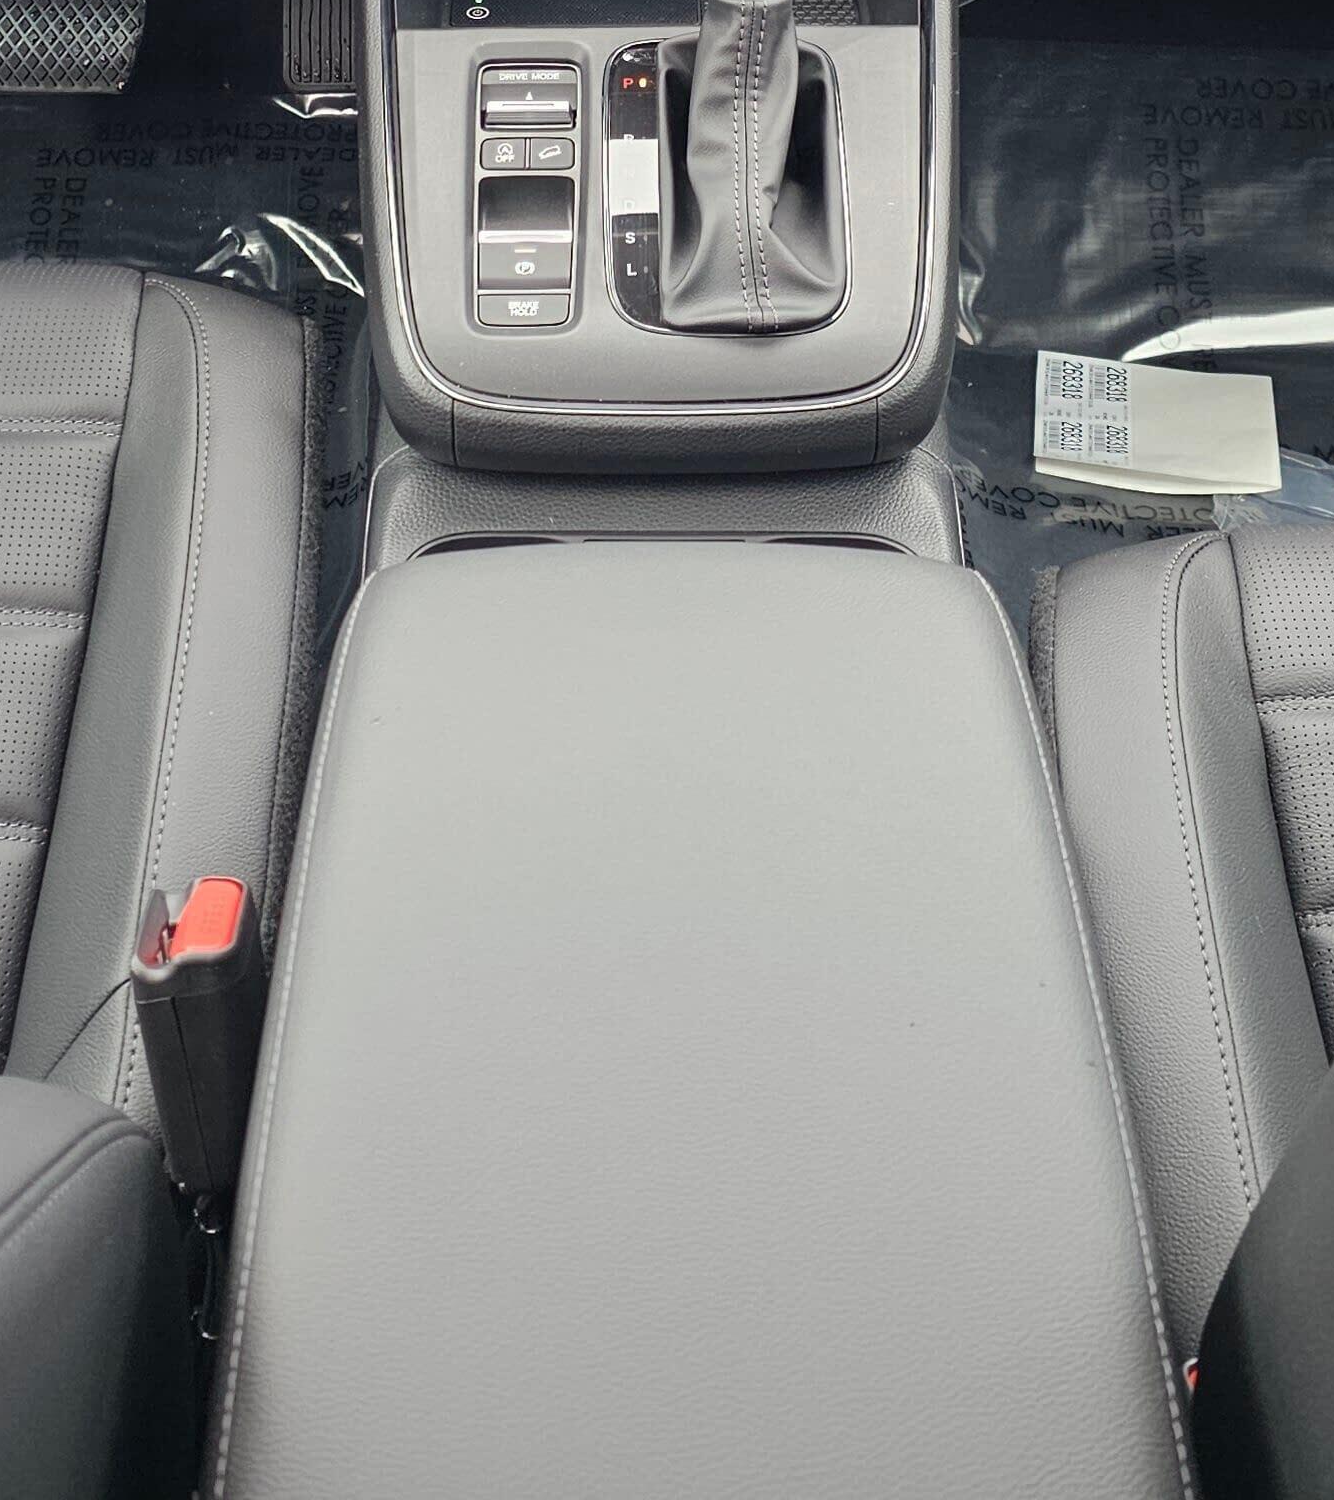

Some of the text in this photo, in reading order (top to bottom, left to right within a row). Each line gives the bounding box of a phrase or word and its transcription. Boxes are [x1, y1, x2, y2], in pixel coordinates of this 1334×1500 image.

[499, 73, 559, 81] DRIVE MODE
[623, 78, 634, 89] P
[495, 154, 515, 164] OFF
[625, 232, 636, 244] S
[626, 264, 637, 277] L
[1061, 360, 1084, 400] 268318
[1106, 366, 1128, 402] 268318
